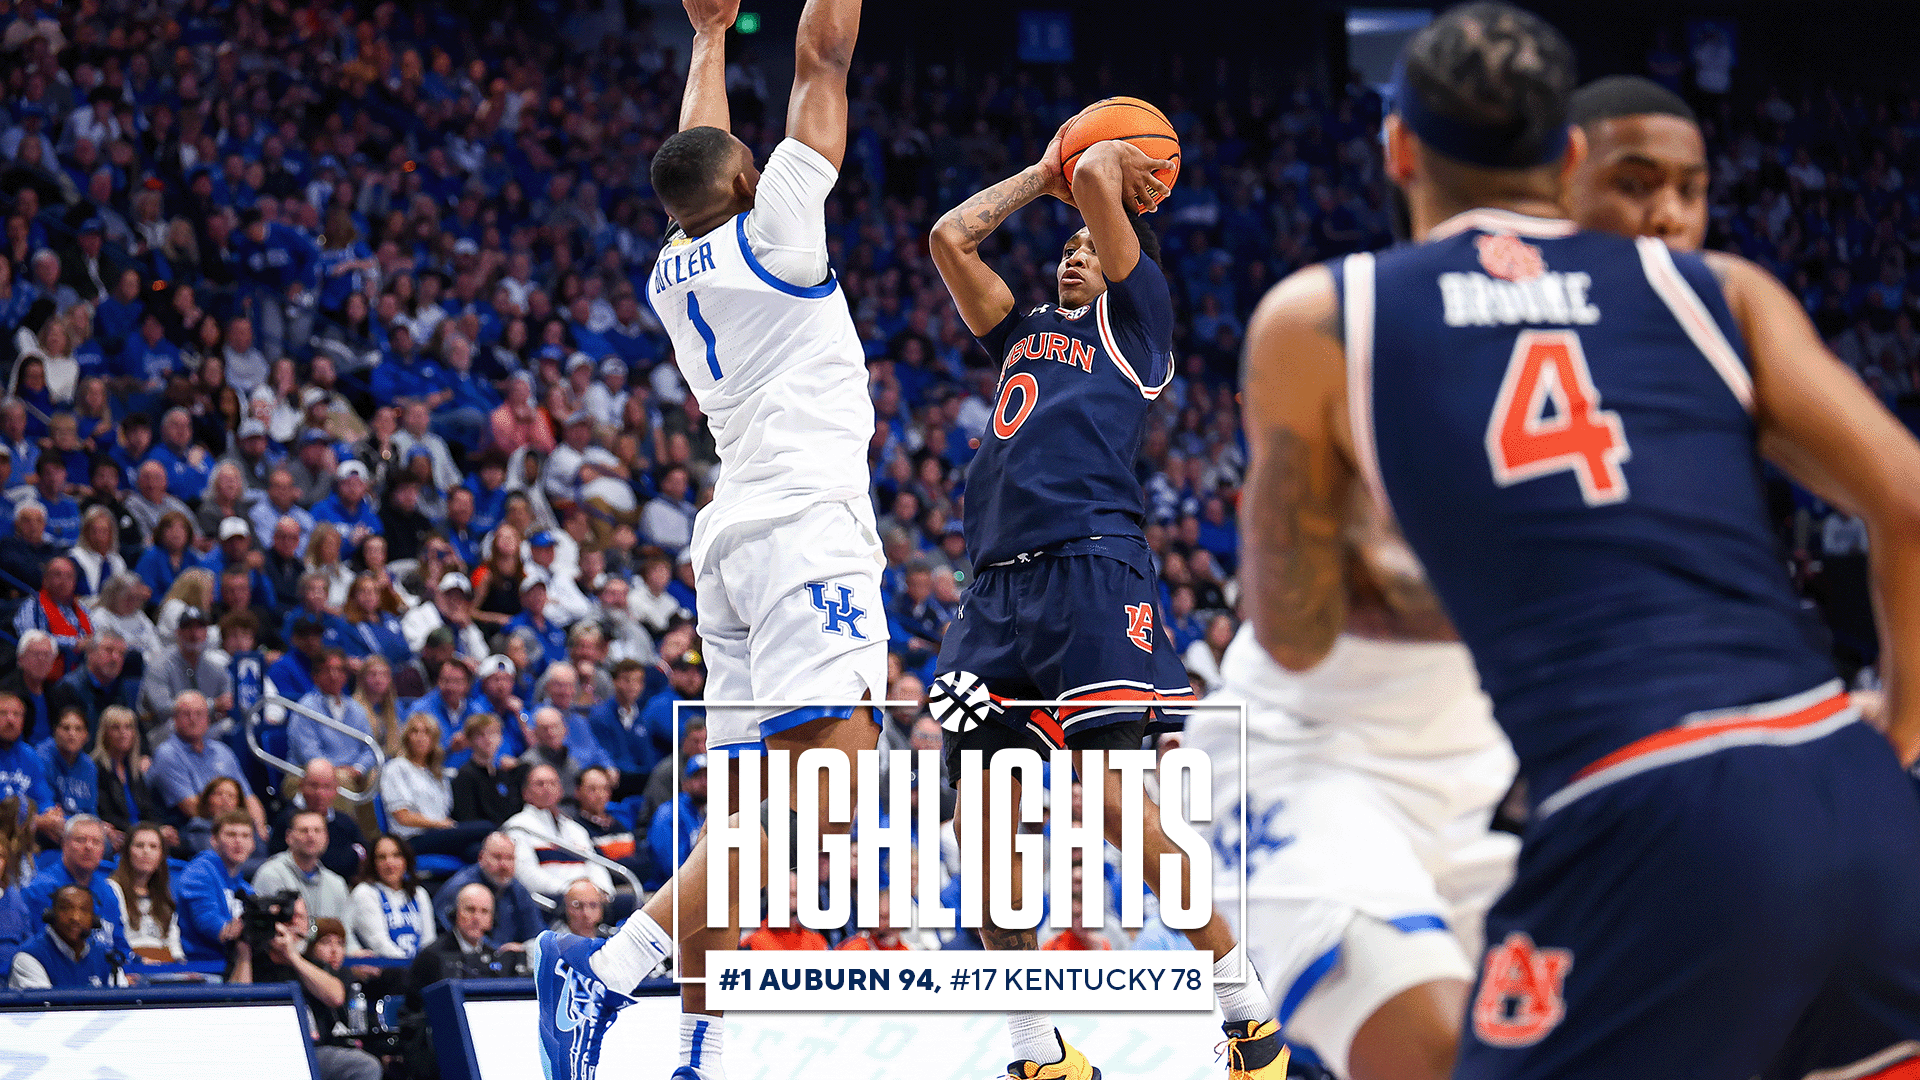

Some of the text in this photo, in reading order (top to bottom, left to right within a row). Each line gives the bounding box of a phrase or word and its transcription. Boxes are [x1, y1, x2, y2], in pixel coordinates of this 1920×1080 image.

[687, 290, 724, 381] 1
[1000, 332, 1096, 383] BURN
[993, 372, 1039, 440] 0
[1483, 328, 1633, 508] 4
[803, 581, 870, 642] UK
